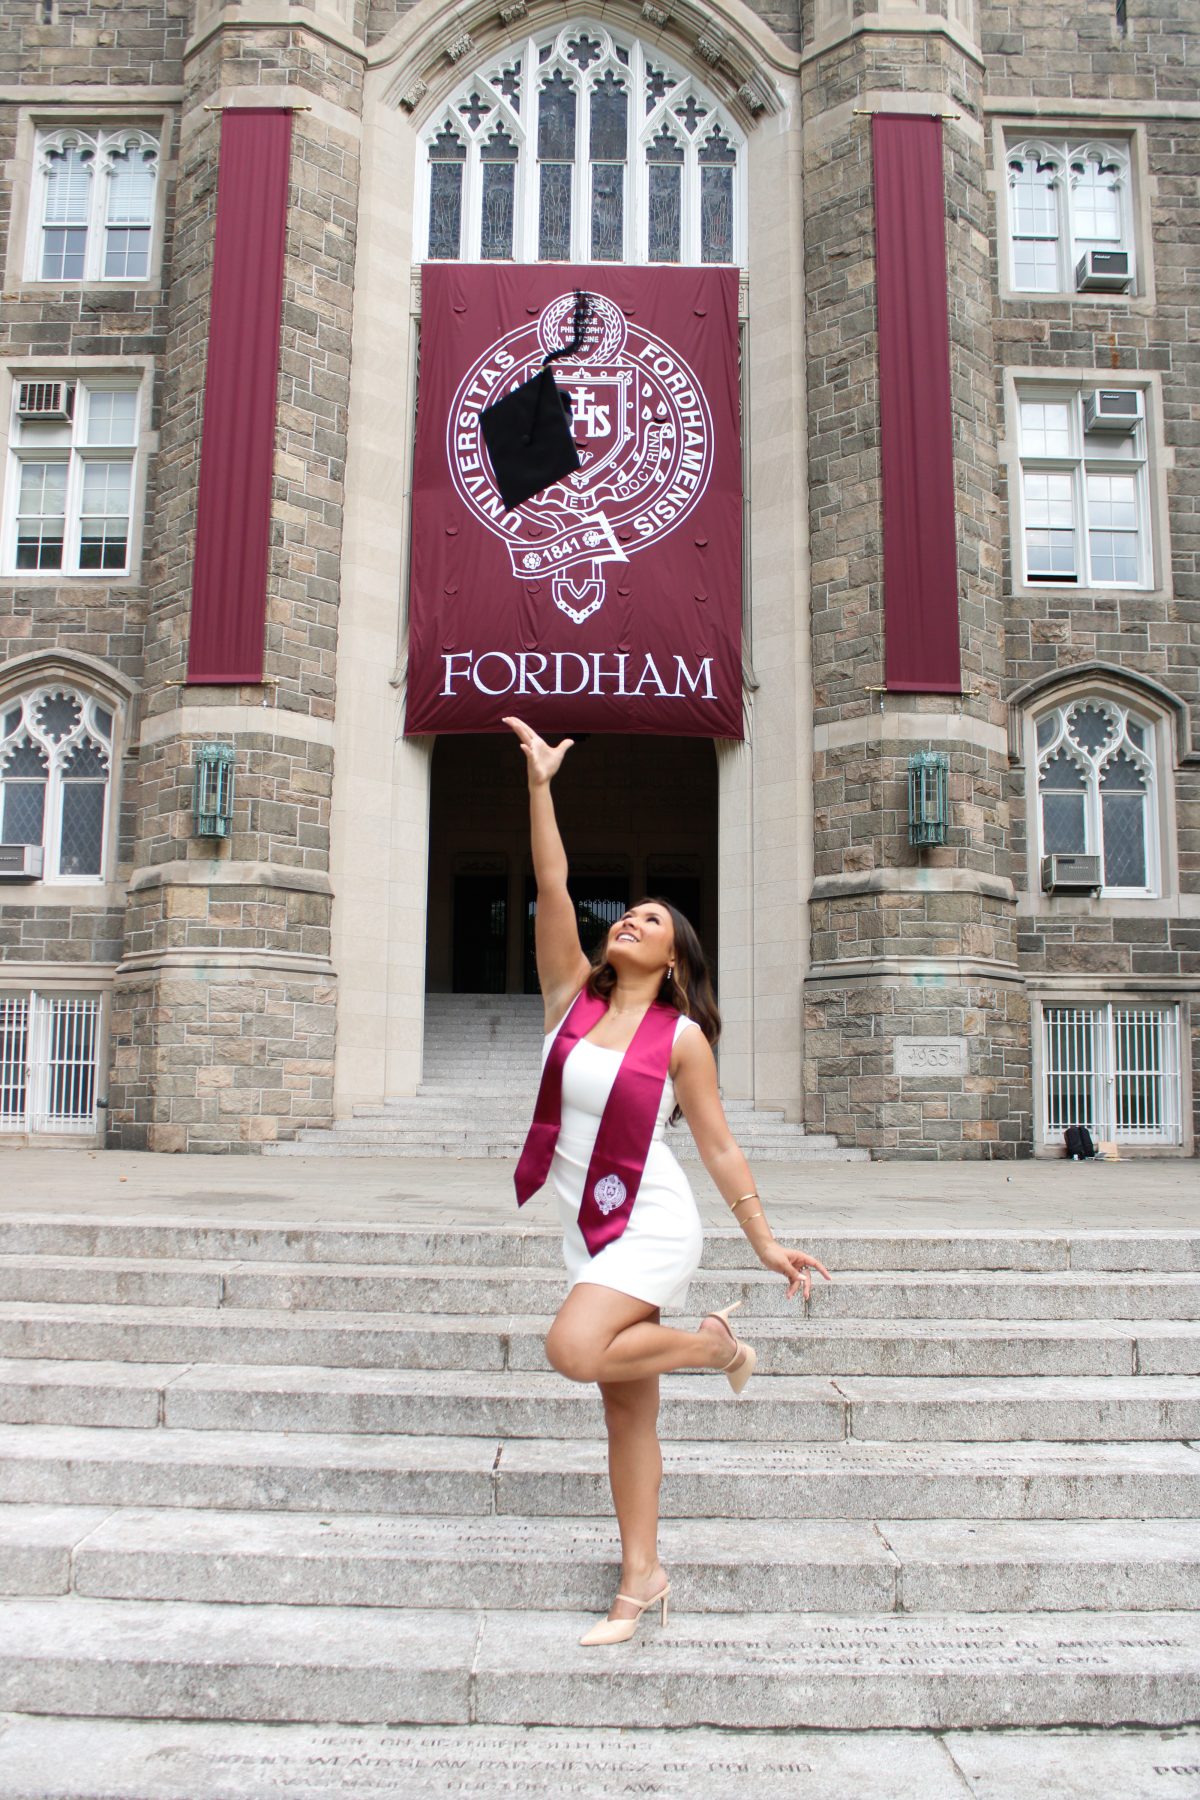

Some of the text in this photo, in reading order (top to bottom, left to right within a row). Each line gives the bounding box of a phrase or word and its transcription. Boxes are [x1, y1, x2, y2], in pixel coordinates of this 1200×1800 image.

[458, 350, 522, 533] UNIVERSITAS
[569, 430, 661, 509] ET DOCTRINA
[634, 344, 704, 536] FORDHAMENSIS
[542, 537, 581, 563] 1841
[440, 650, 718, 700] FORDHAM
